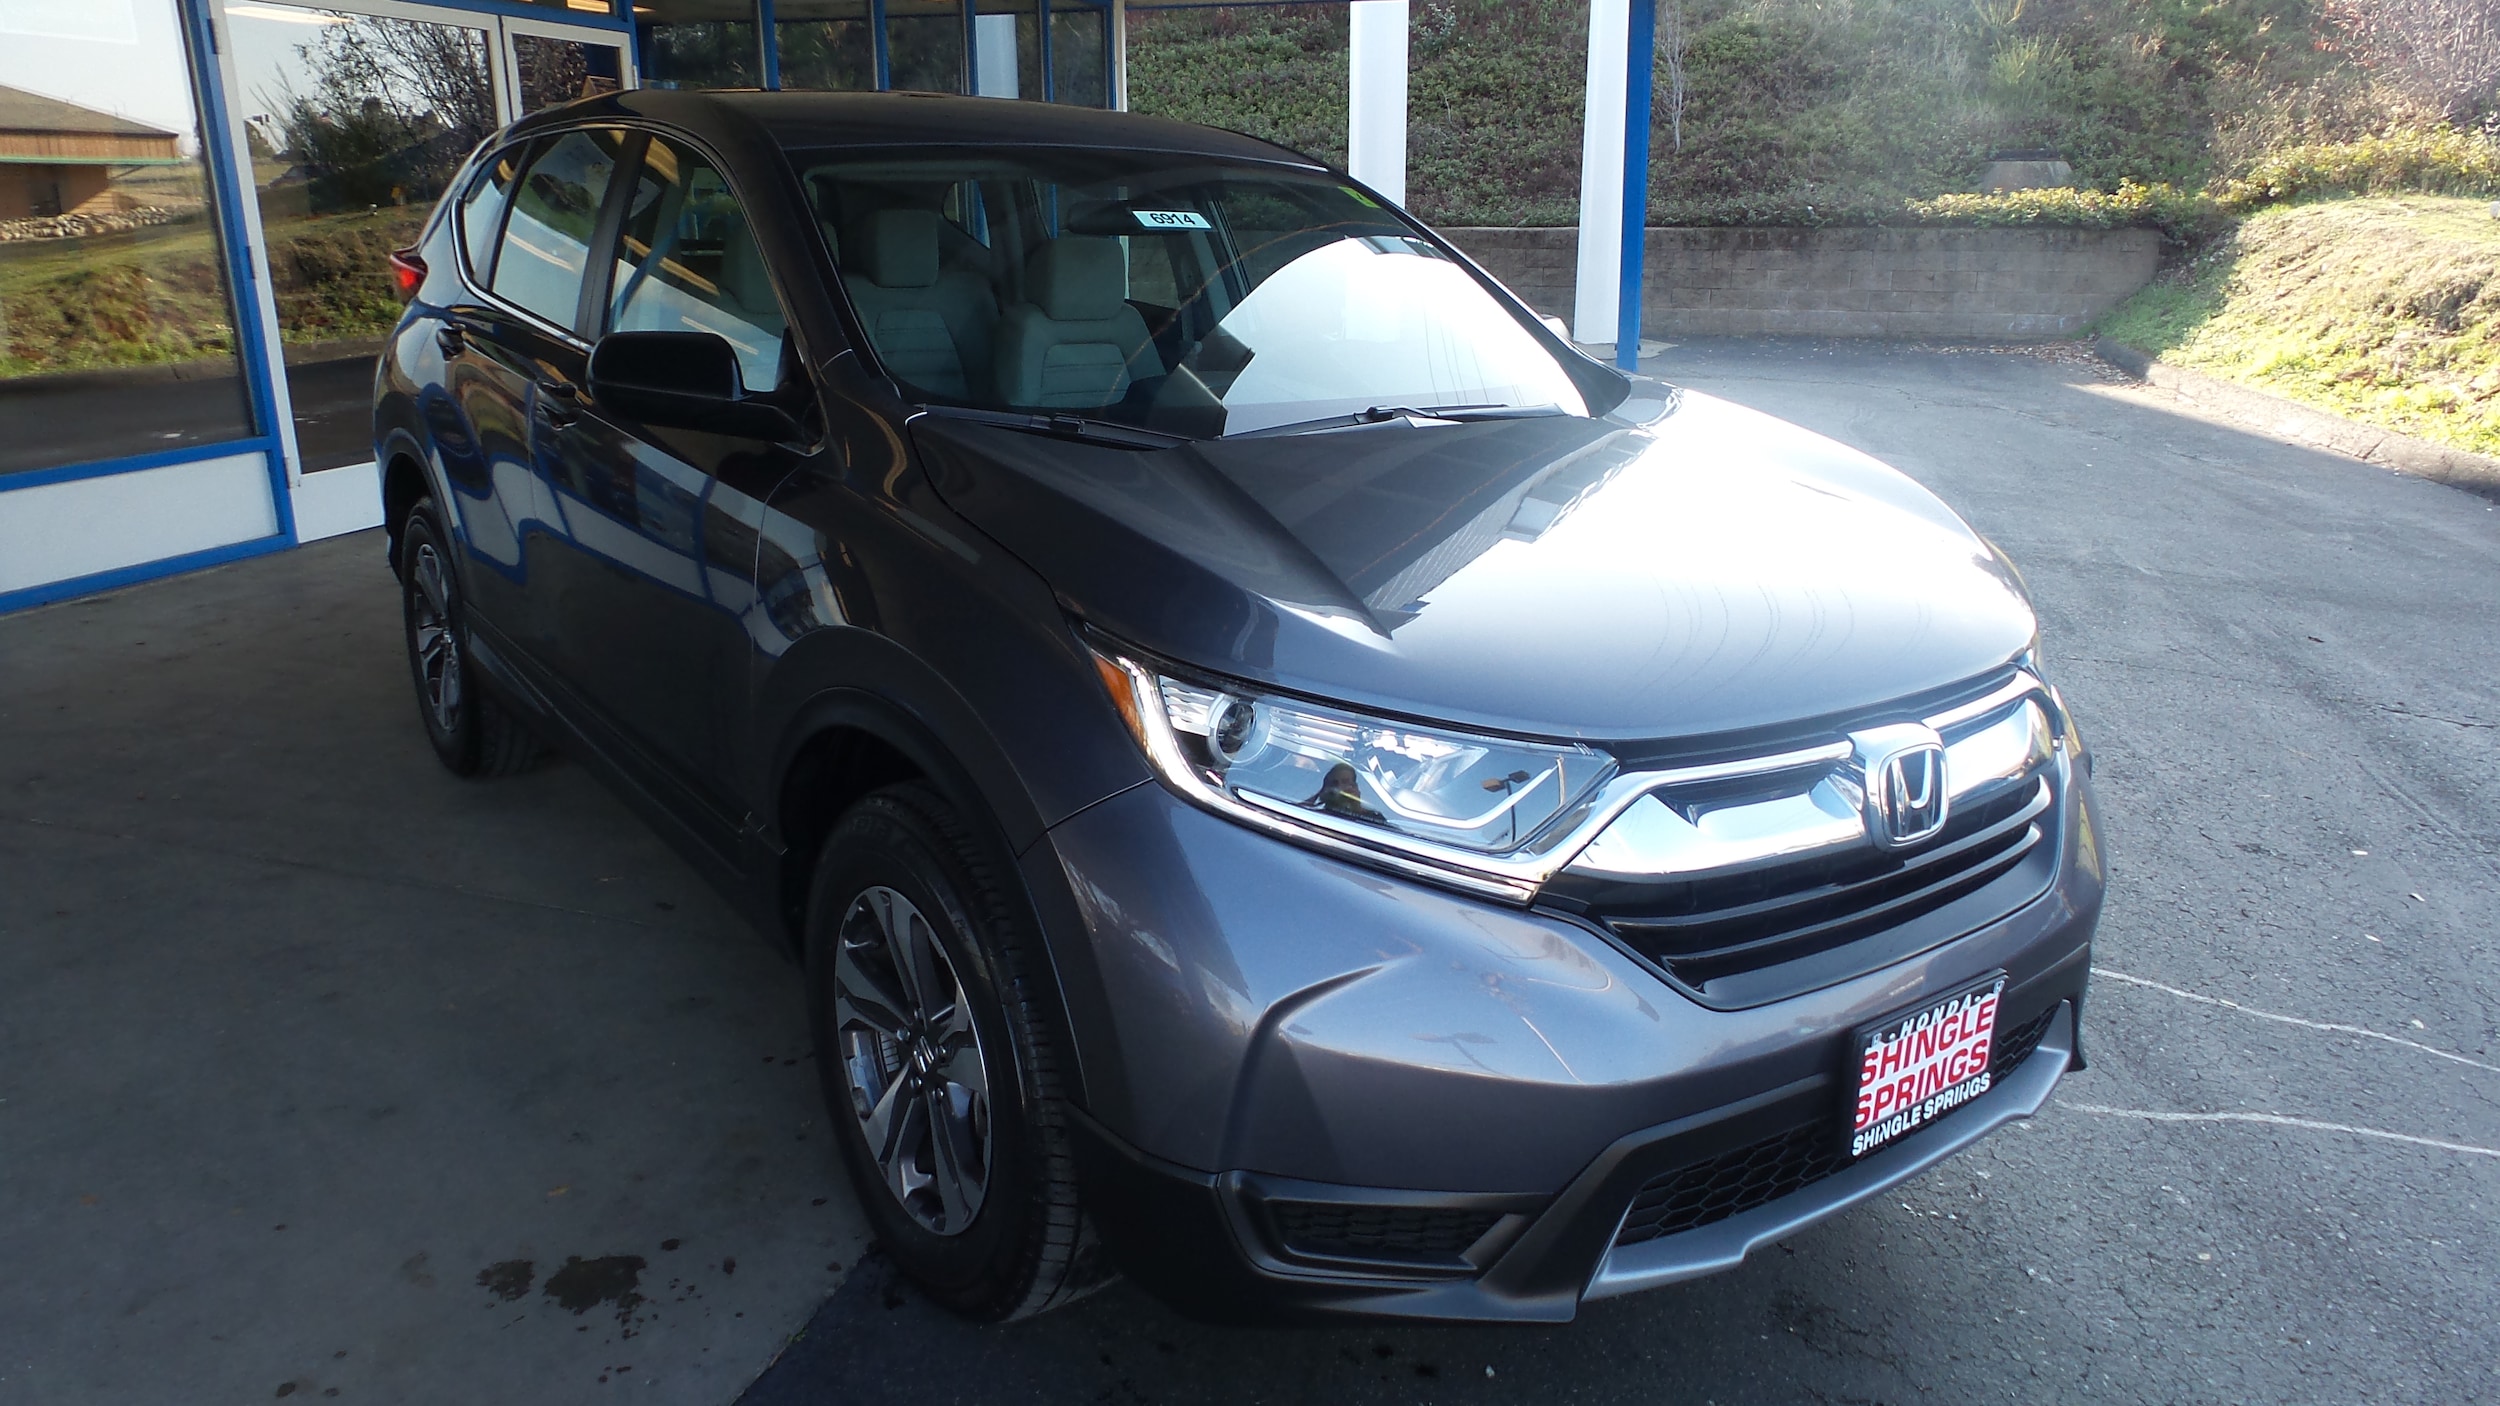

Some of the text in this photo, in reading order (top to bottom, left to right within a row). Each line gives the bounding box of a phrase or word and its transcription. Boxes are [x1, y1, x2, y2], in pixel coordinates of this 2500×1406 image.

[1150, 213, 1196, 225] 6914
[1859, 997, 1996, 1088] SHINGLE
[1901, 994, 1971, 1037] HONDA
[1852, 1072, 1991, 1156] SHINGLE SPRINGS
[1855, 1039, 1988, 1130] SPRINGS
